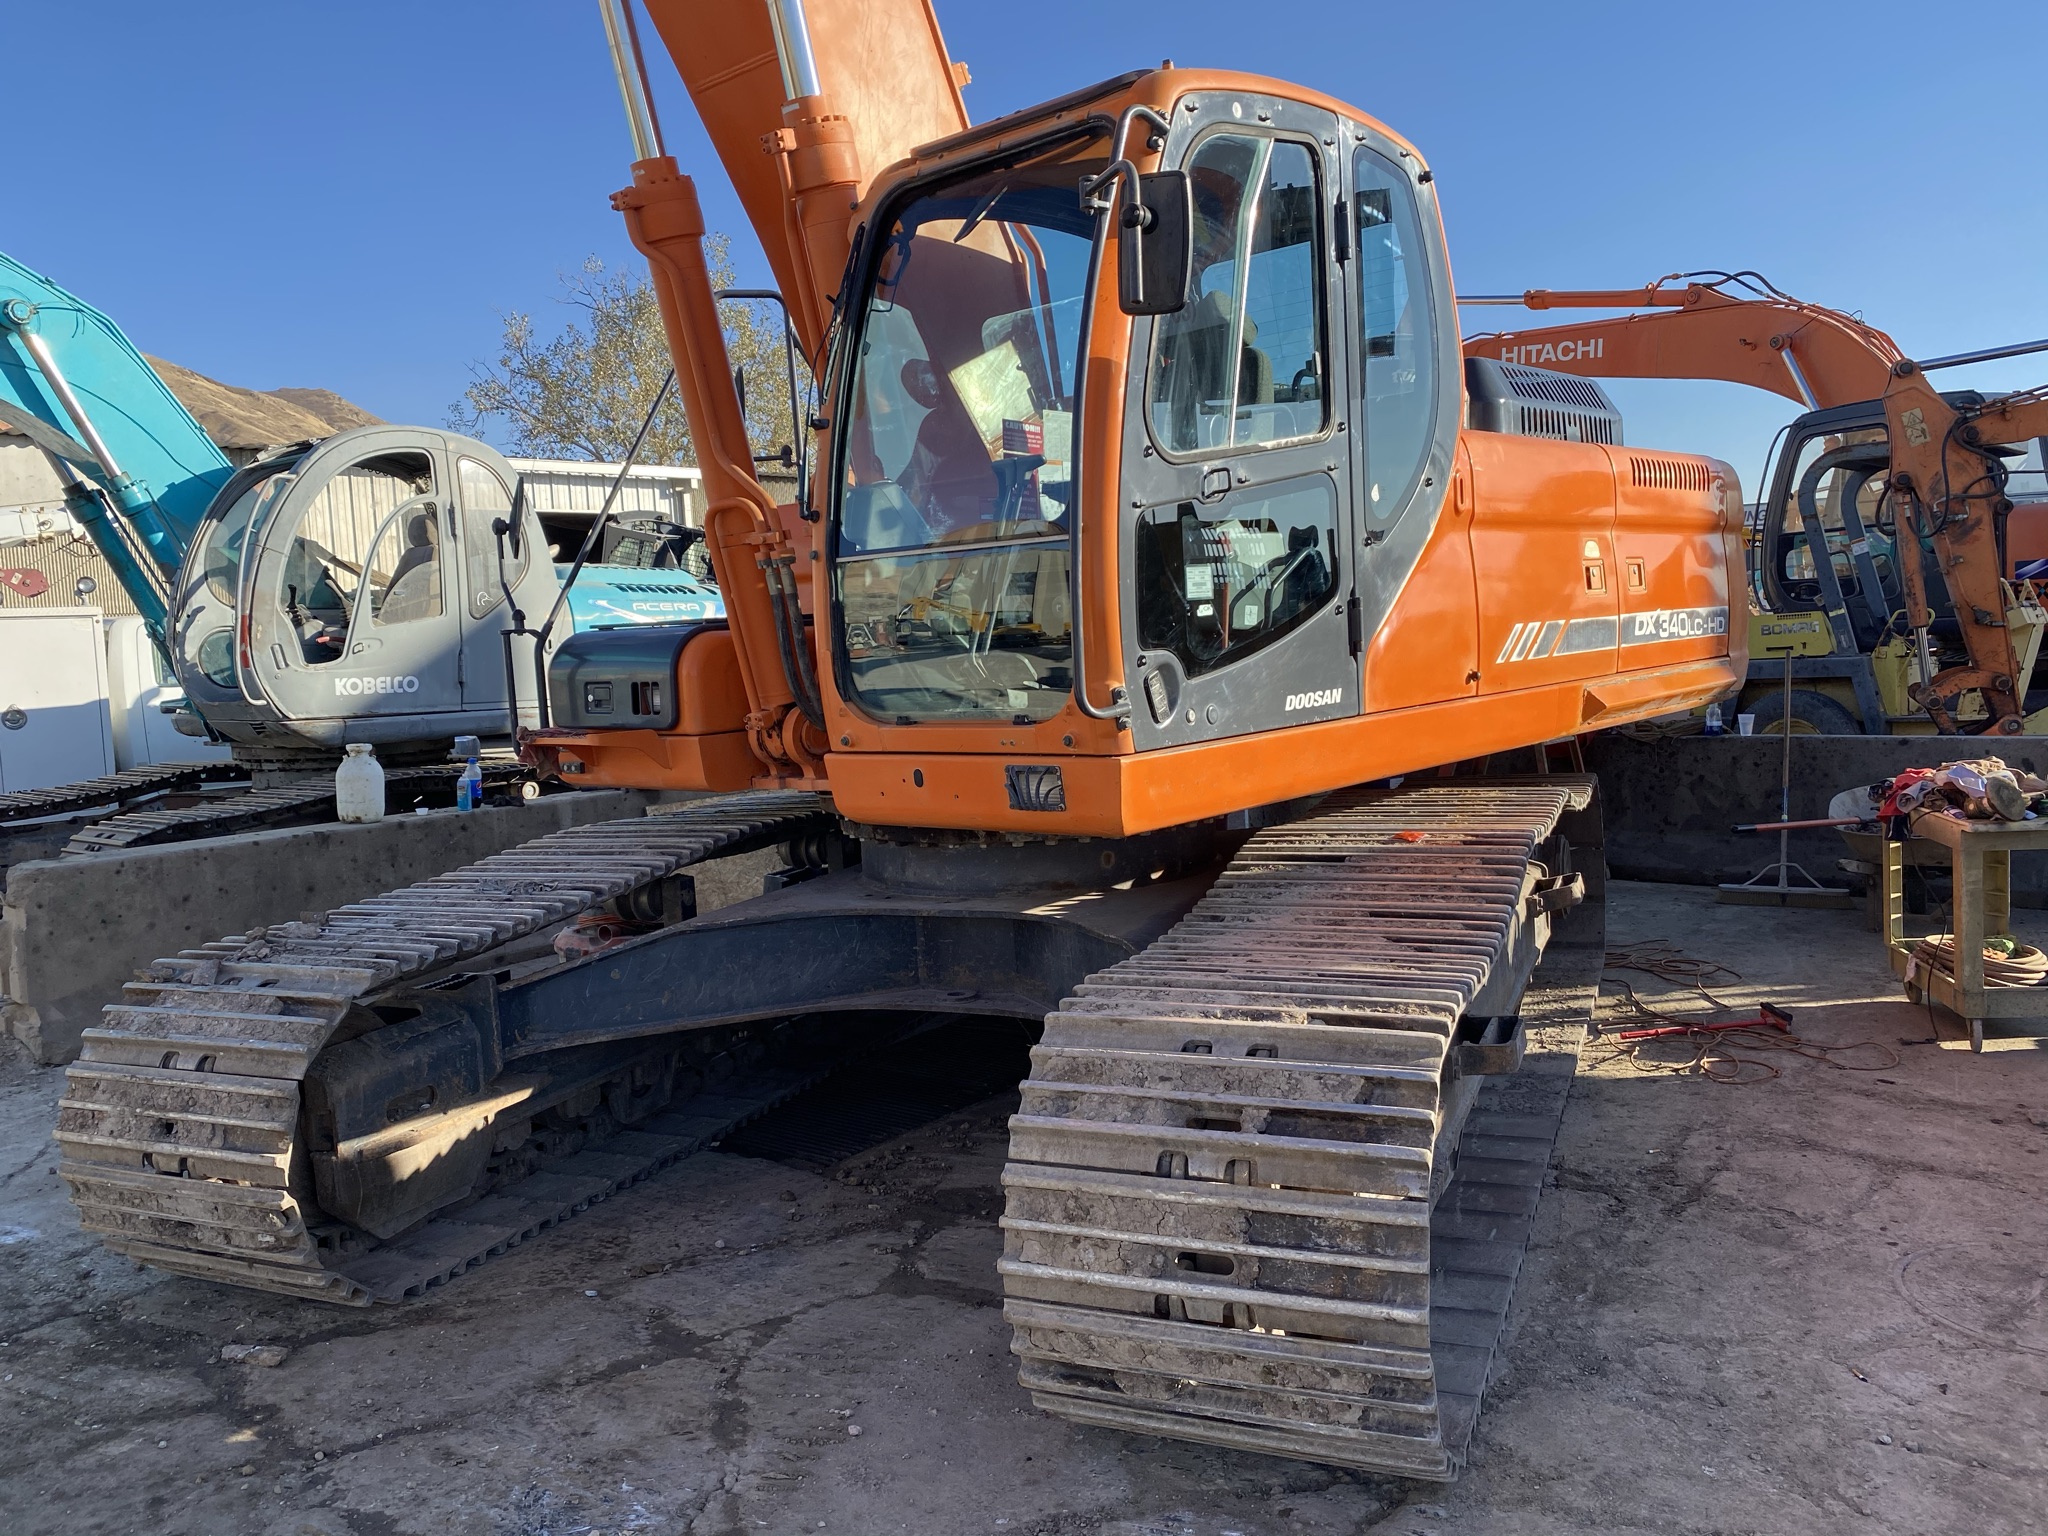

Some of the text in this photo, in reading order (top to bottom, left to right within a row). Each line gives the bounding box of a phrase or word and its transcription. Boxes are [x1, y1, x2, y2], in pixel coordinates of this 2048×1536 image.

[1501, 338, 1604, 365] HITACHI
[632, 602, 701, 612] ACERA
[1760, 621, 1820, 636] BOMAG
[334, 675, 420, 696] KOBELCO
[1284, 687, 1343, 712] DOOSAN
